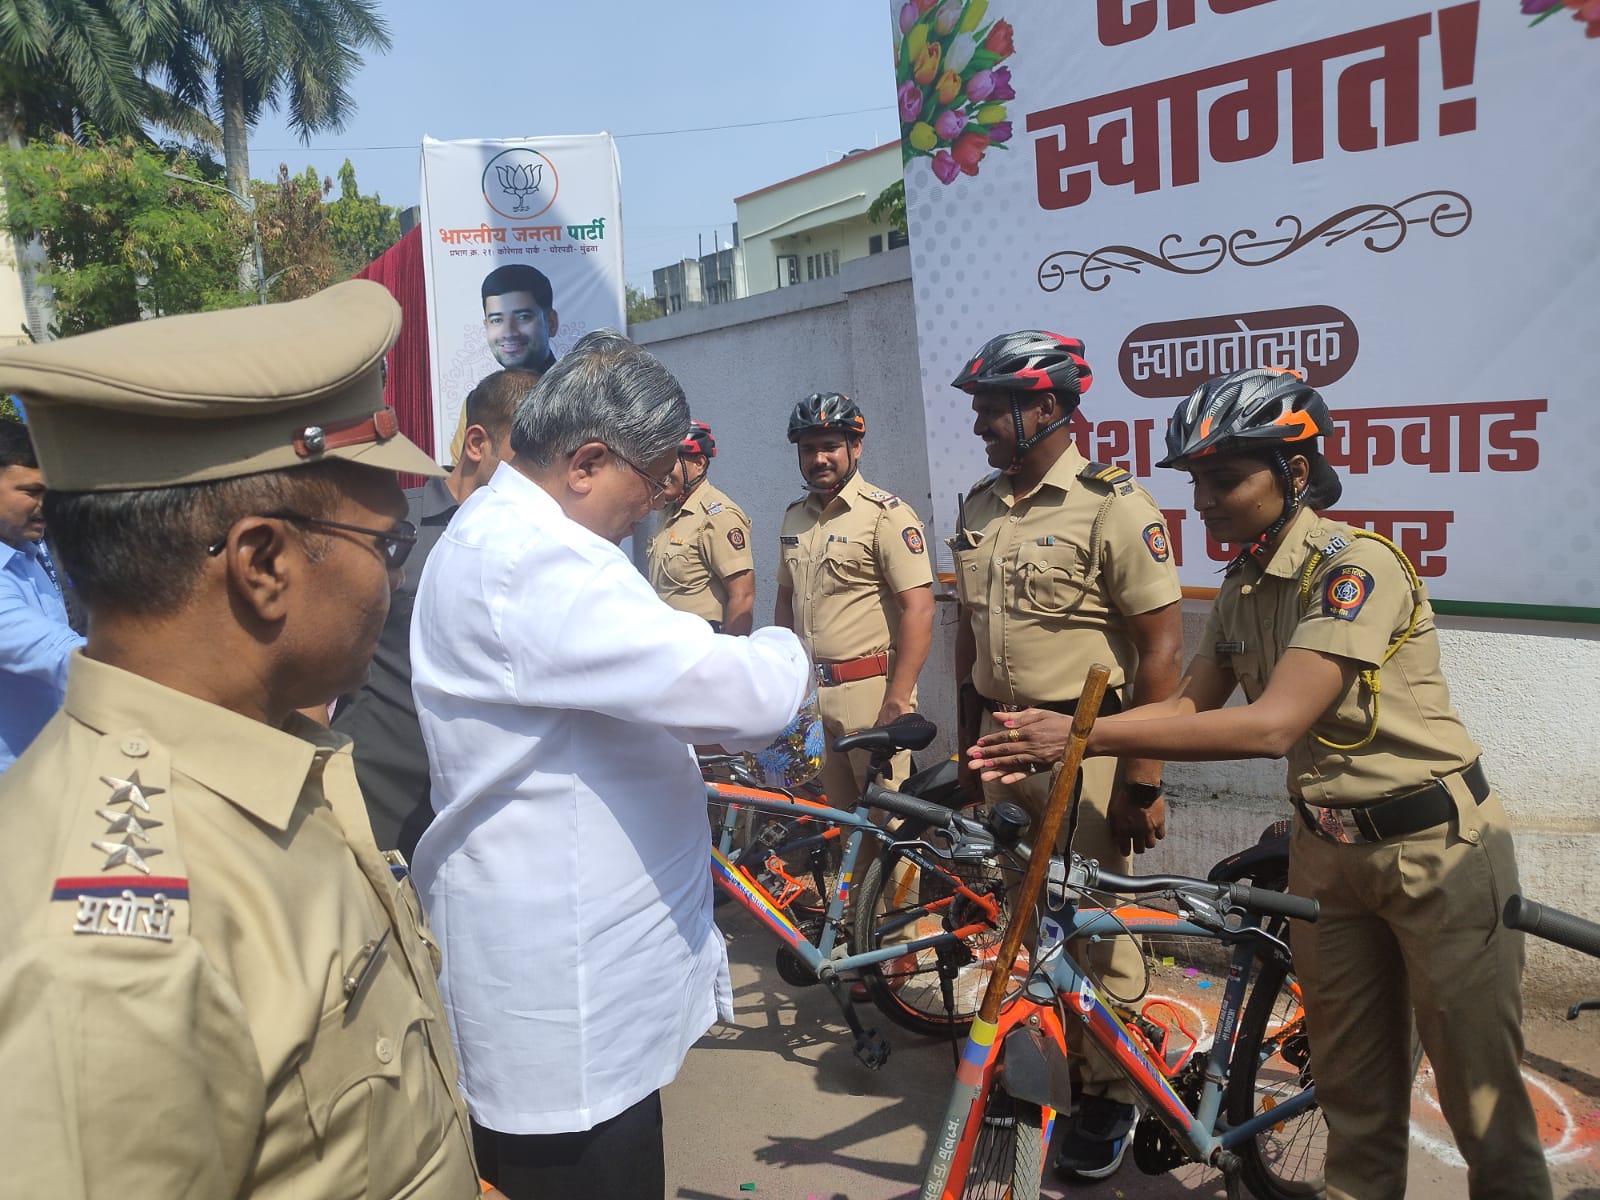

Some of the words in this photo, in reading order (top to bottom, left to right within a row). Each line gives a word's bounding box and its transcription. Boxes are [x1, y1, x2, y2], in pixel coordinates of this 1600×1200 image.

[1026, 1, 1480, 210] स्वागत!
[439, 223, 507, 245] भारतीय
[512, 225, 562, 242] जनता
[566, 218, 606, 241] पार्टी
[1128, 319, 1345, 382] स्वागतोत्सुक
